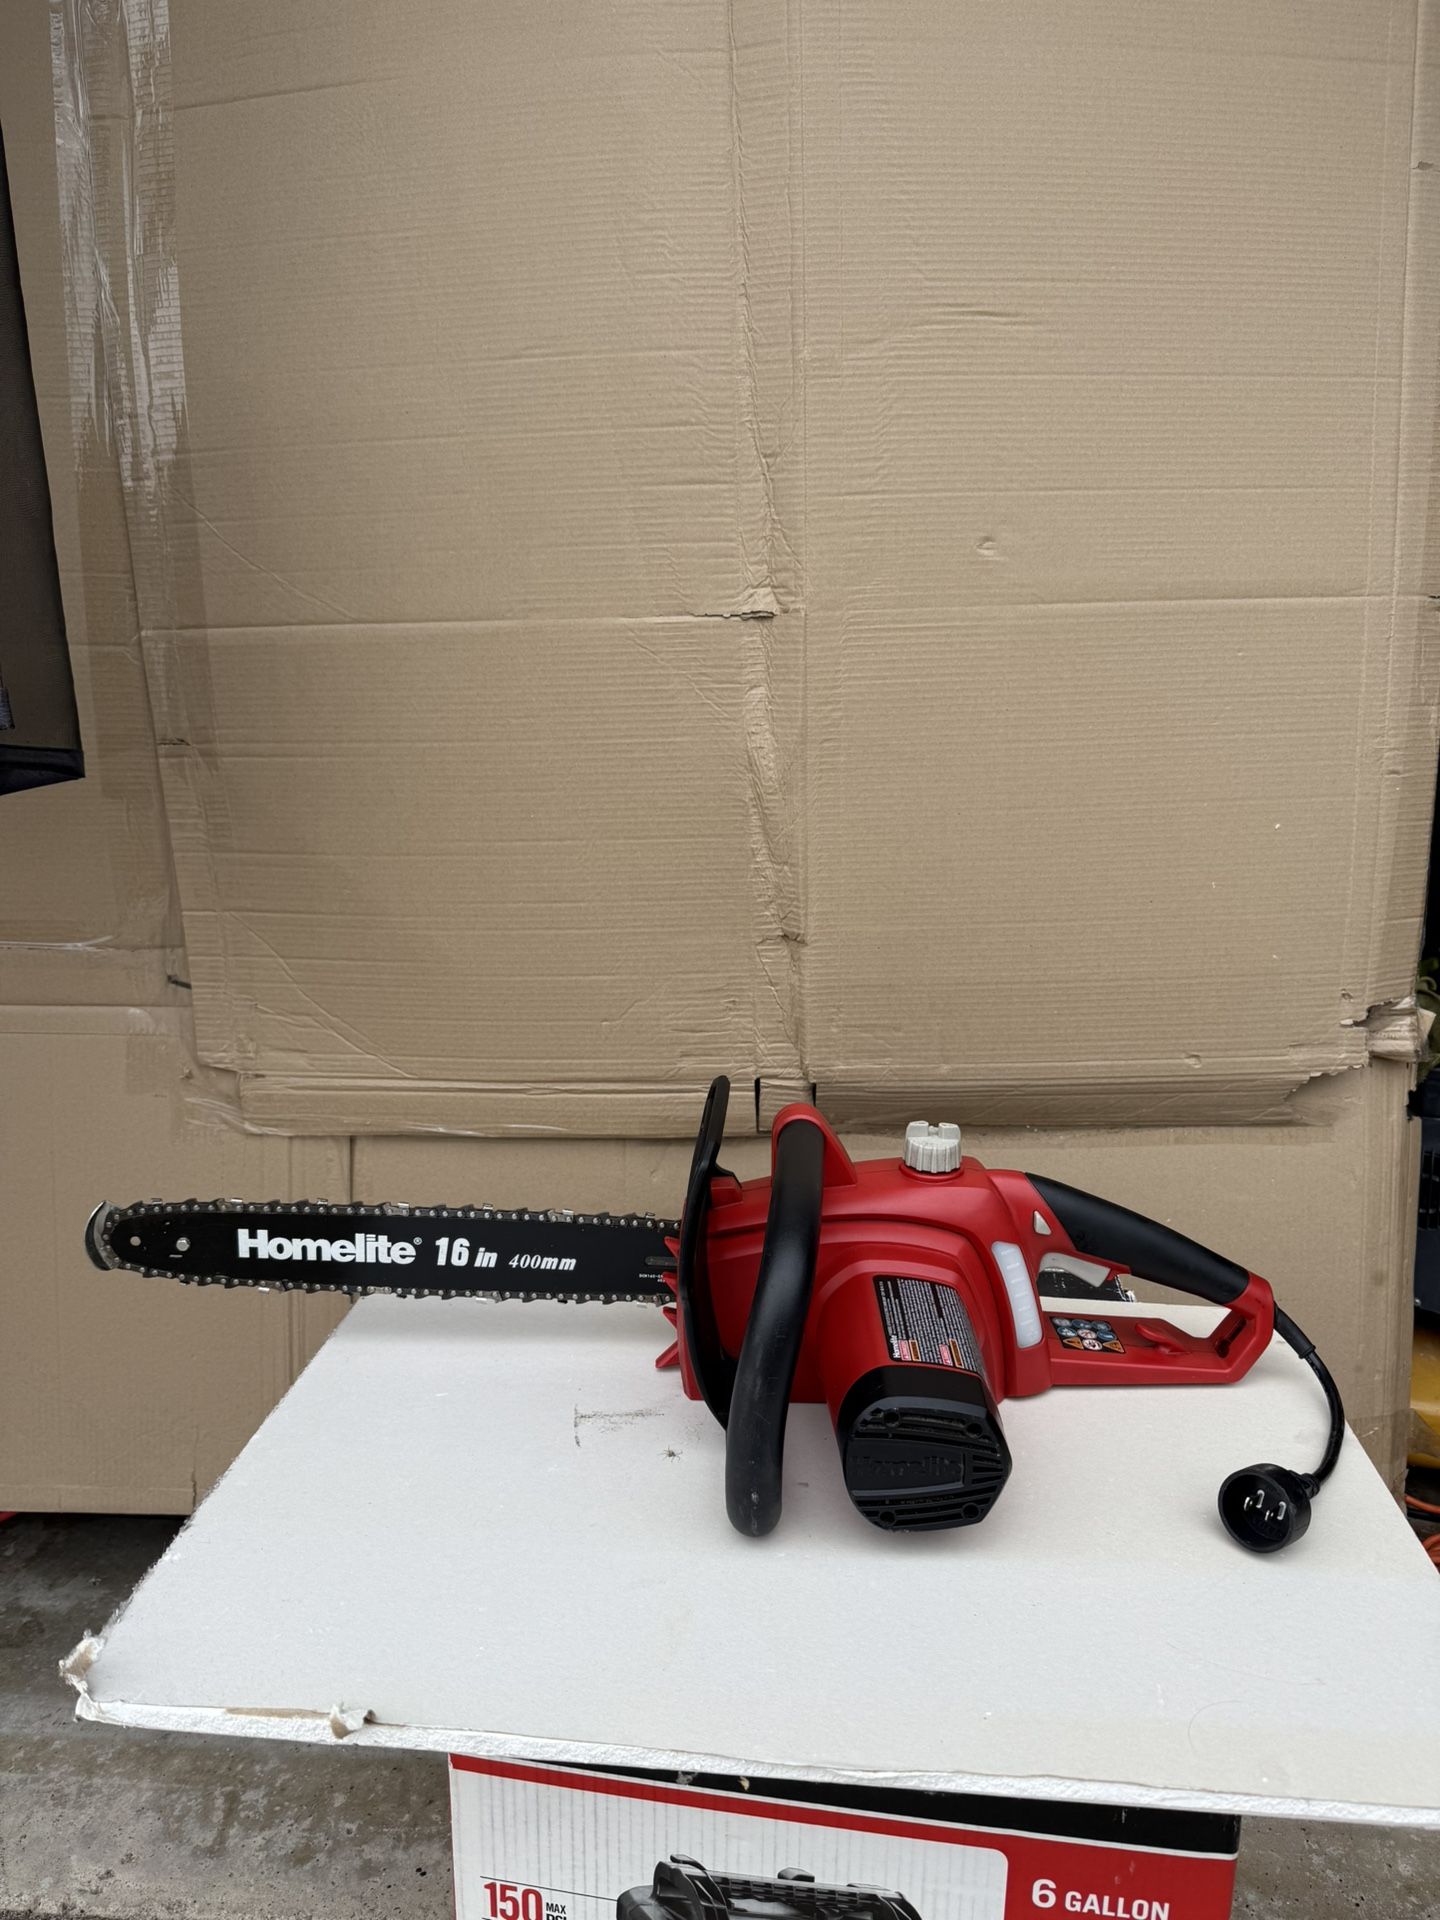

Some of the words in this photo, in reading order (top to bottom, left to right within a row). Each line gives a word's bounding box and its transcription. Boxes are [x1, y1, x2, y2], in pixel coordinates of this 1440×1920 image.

[435, 1237, 470, 1267] 16
[474, 1247, 498, 1268] in
[508, 1253, 577, 1271] 400mm
[484, 1882, 543, 1920] 150
[546, 1902, 566, 1914] MAX
[1031, 1878, 1057, 1909] 6
[1064, 1890, 1170, 1920] GALLON
